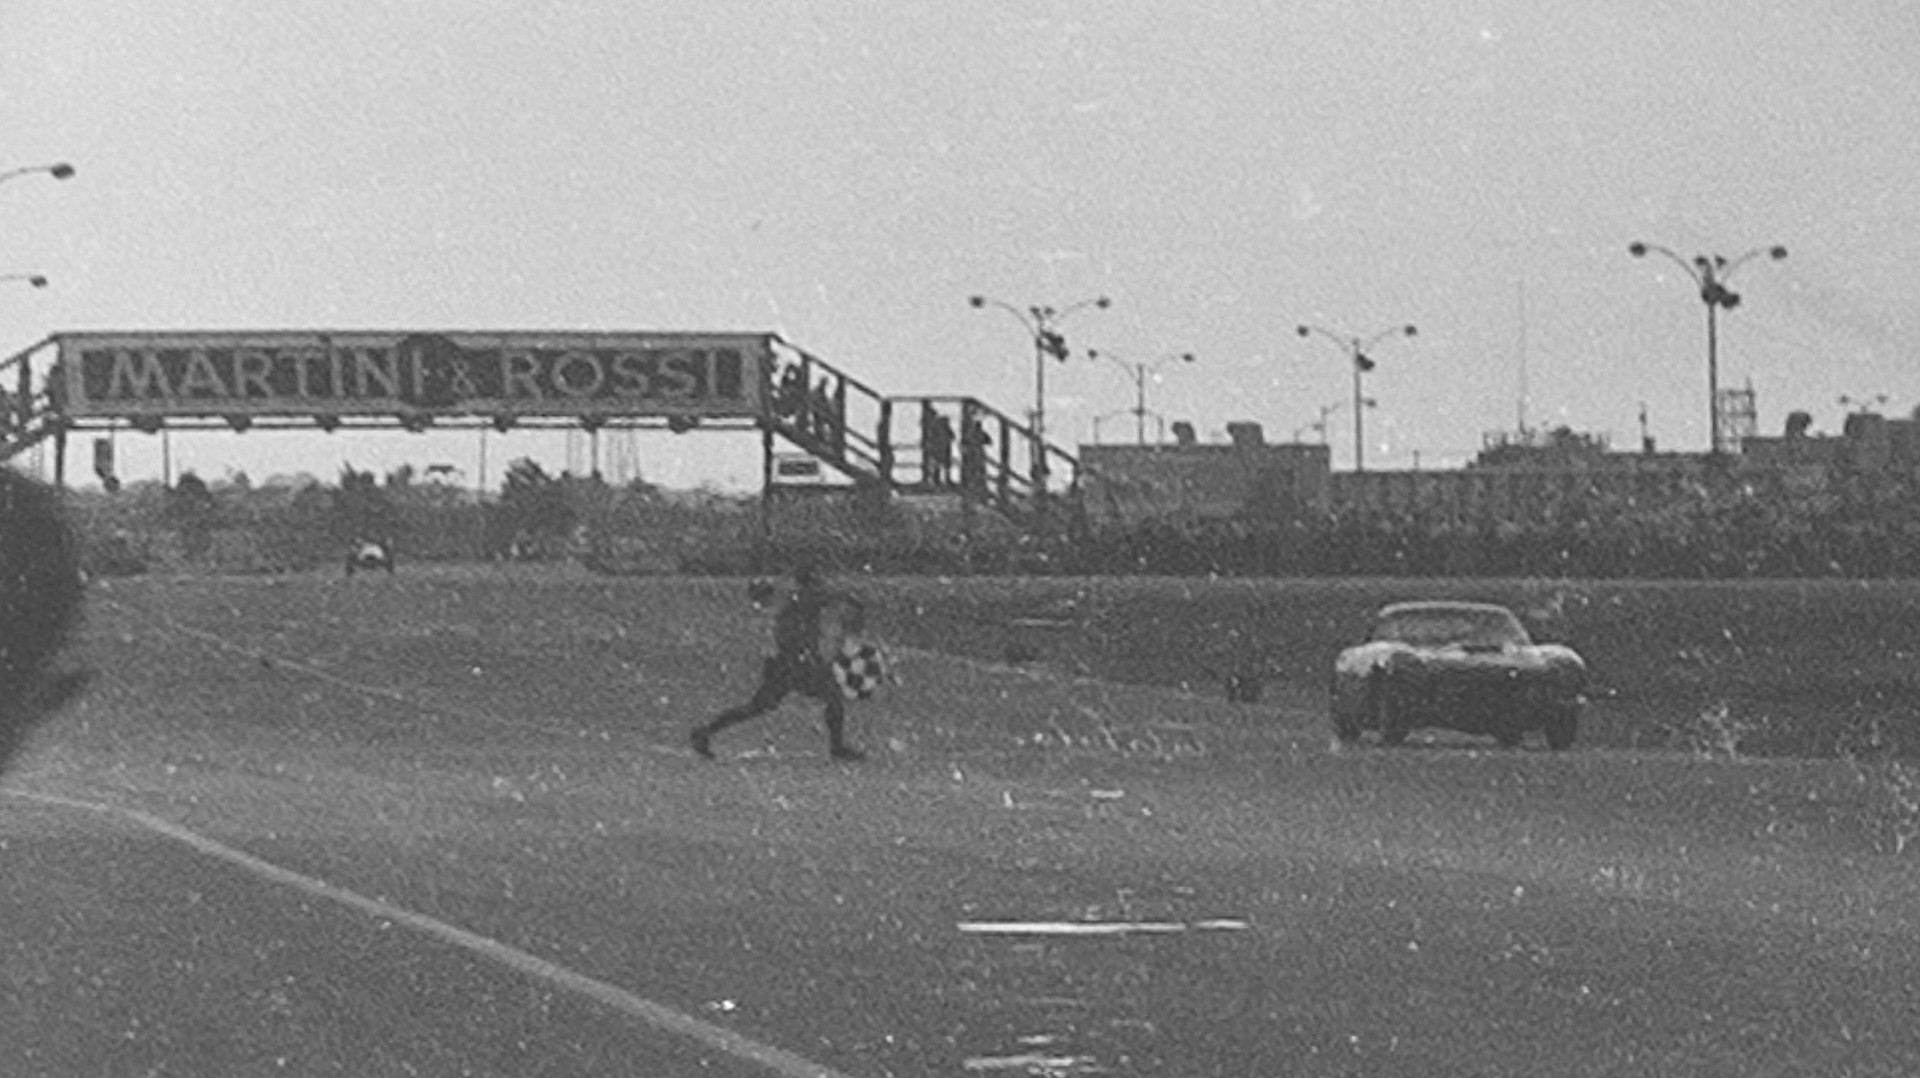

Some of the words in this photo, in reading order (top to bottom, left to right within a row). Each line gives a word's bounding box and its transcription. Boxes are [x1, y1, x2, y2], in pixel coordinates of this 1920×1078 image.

[108, 350, 424, 398] MARTINI
[452, 358, 478, 396] &
[505, 350, 717, 398] ROSSI
